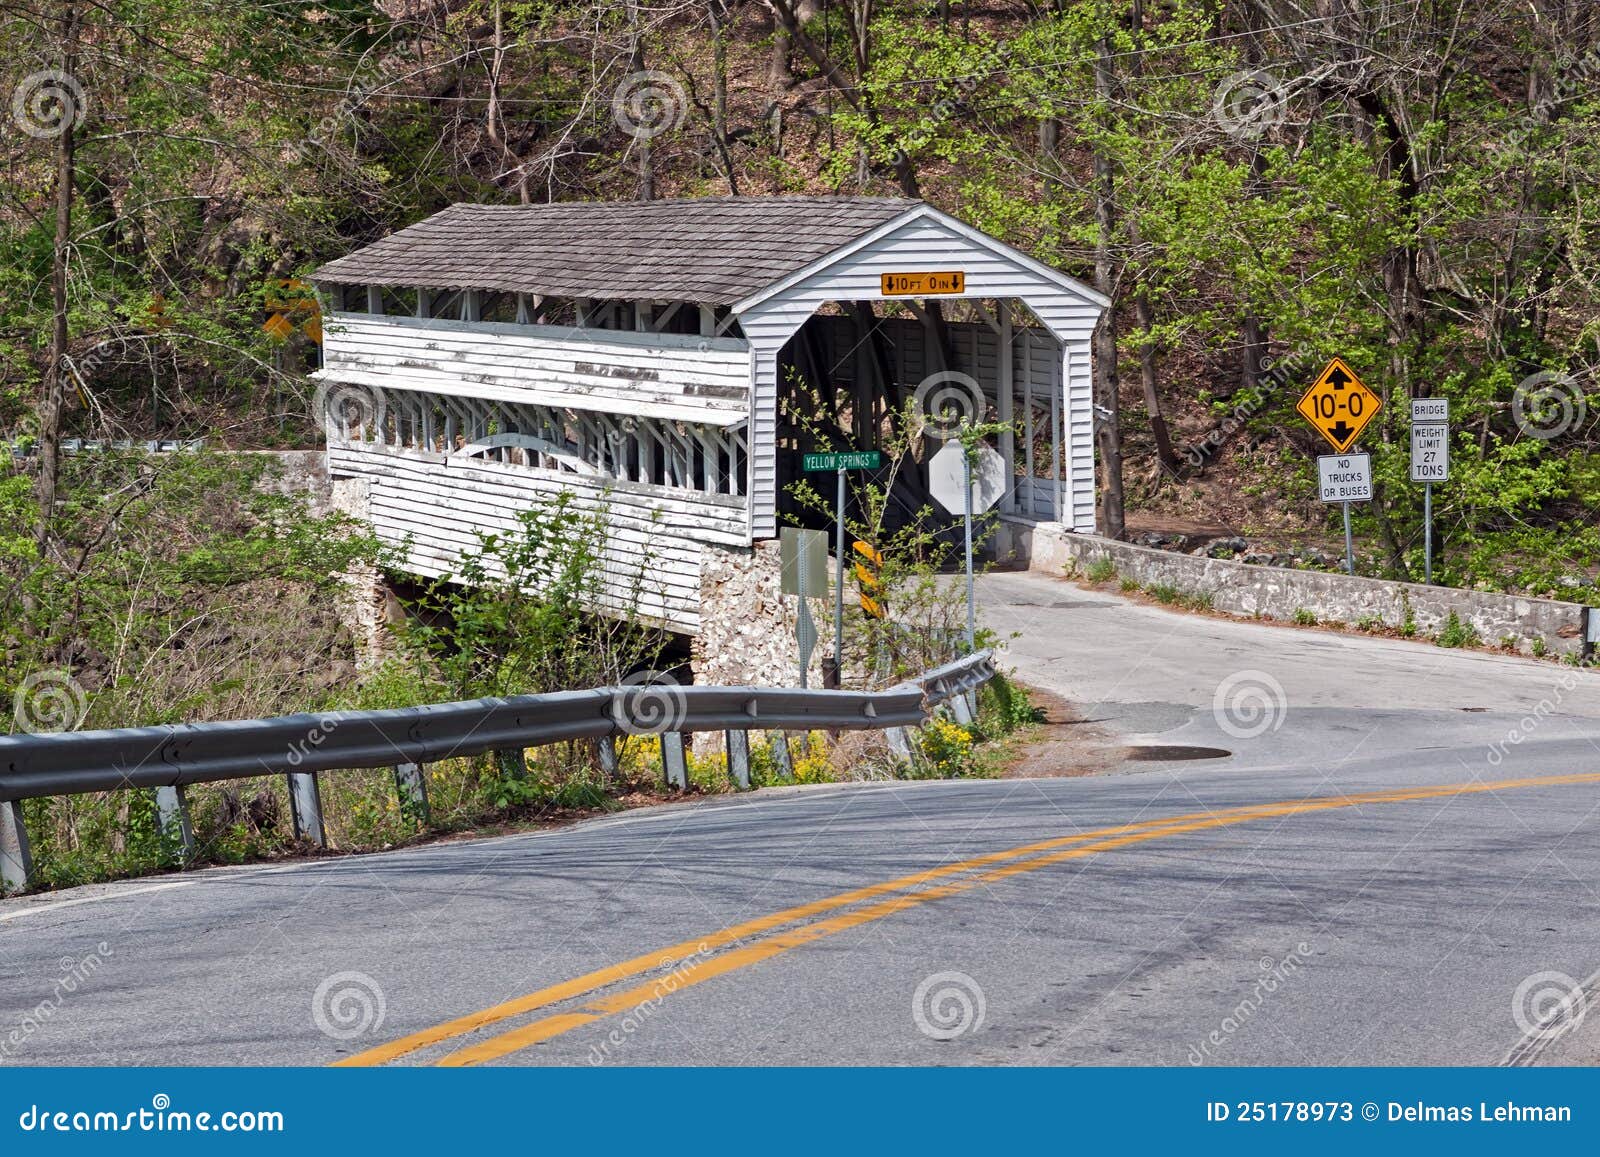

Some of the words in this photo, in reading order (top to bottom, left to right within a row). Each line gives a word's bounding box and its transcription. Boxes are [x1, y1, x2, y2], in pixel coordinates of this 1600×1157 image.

[1414, 405, 1445, 415] BRIDGE
[1414, 428, 1445, 438] WEIGHT
[1419, 439, 1440, 449] LIMIT
[806, 456, 835, 469] YELLOW
[838, 454, 870, 468] SPRINGS
[1423, 452, 1436, 463] 27
[1337, 459, 1350, 469] NO
[1416, 465, 1444, 476] TONS
[1328, 472, 1363, 483] TRUCKS
[1323, 488, 1336, 498] OR
[1339, 486, 1369, 497] BUSES
